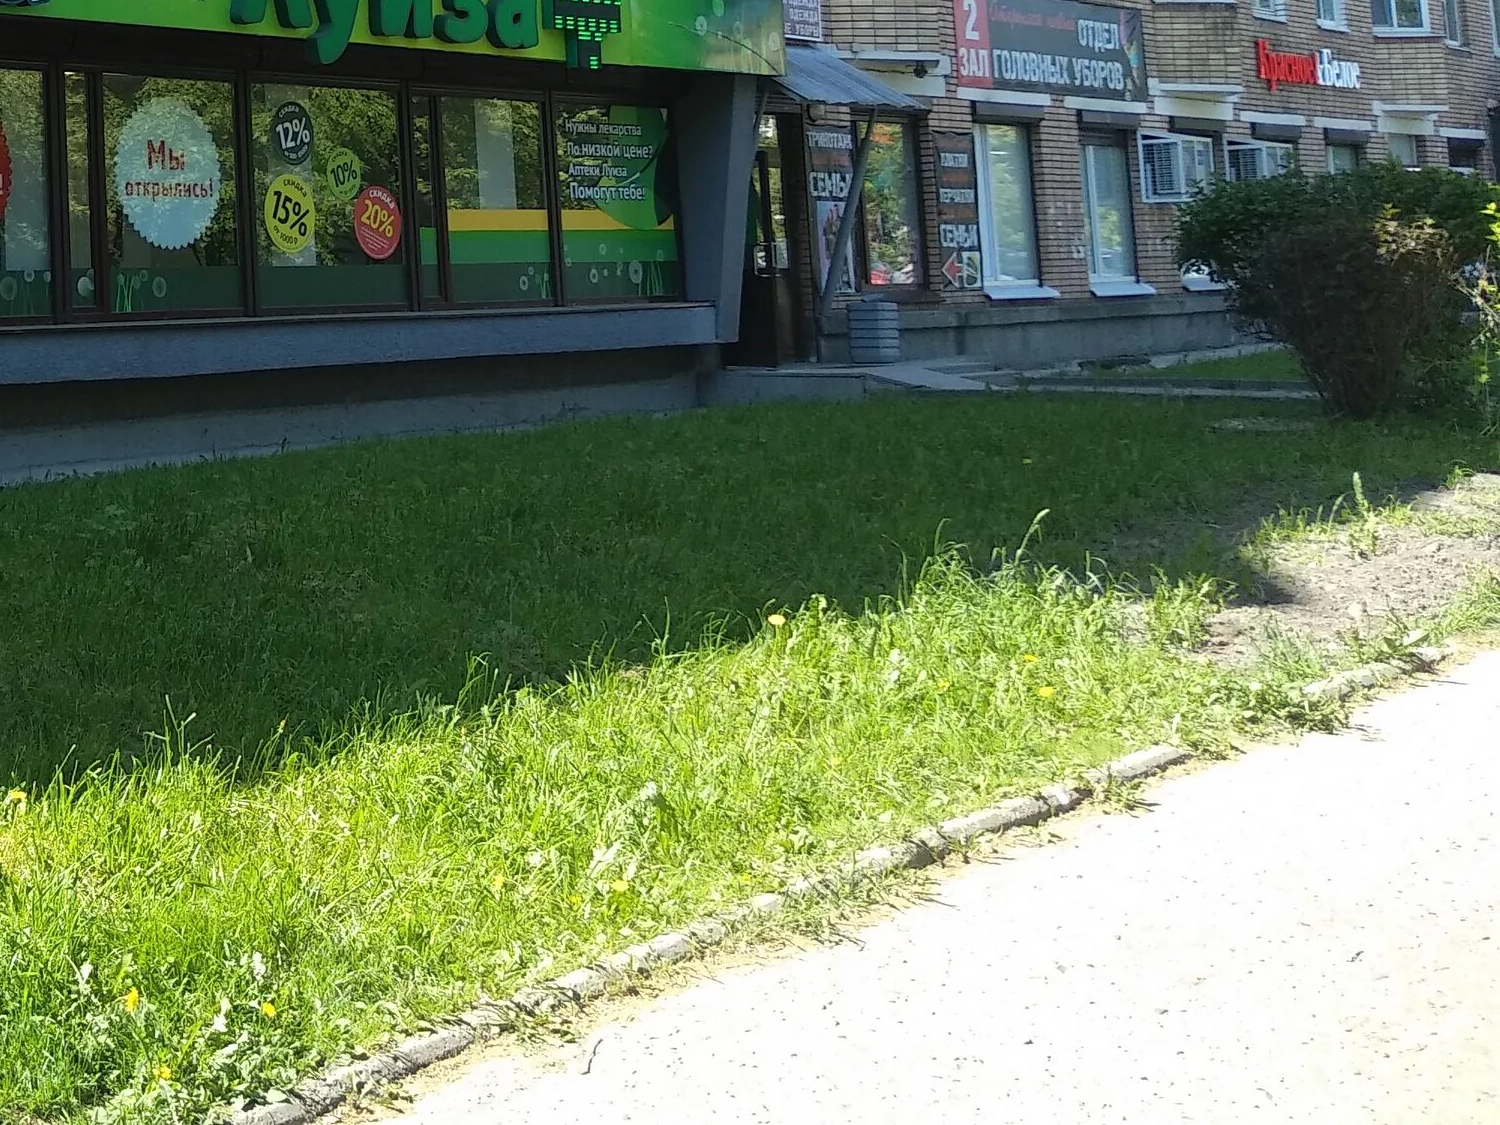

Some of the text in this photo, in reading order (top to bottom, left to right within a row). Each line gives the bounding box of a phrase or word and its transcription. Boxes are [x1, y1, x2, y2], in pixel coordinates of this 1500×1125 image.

[789, 8, 819, 24] ОДЕЖДА
[1077, 18, 1120, 53] ОТДЕЛ
[959, 47, 1126, 91] ЗАЛ ГОЛОВНЫХ УБОРОВ
[275, 117, 311, 150] 12%
[565, 119, 642, 137] Нужны лекарства
[146, 138, 187, 171] Мы
[567, 140, 653, 160] По низкой цене?
[330, 160, 358, 188] 10%
[568, 162, 628, 179] Аптеки Луиза
[124, 177, 214, 202] открылись!
[282, 178, 308, 198] скидка
[369, 189, 395, 209] скидка
[569, 182, 645, 203] Помогут тебе!
[272, 190, 309, 237] 15%
[361, 199, 394, 238] 20%
[939, 224, 979, 248] СЕМЬИ
